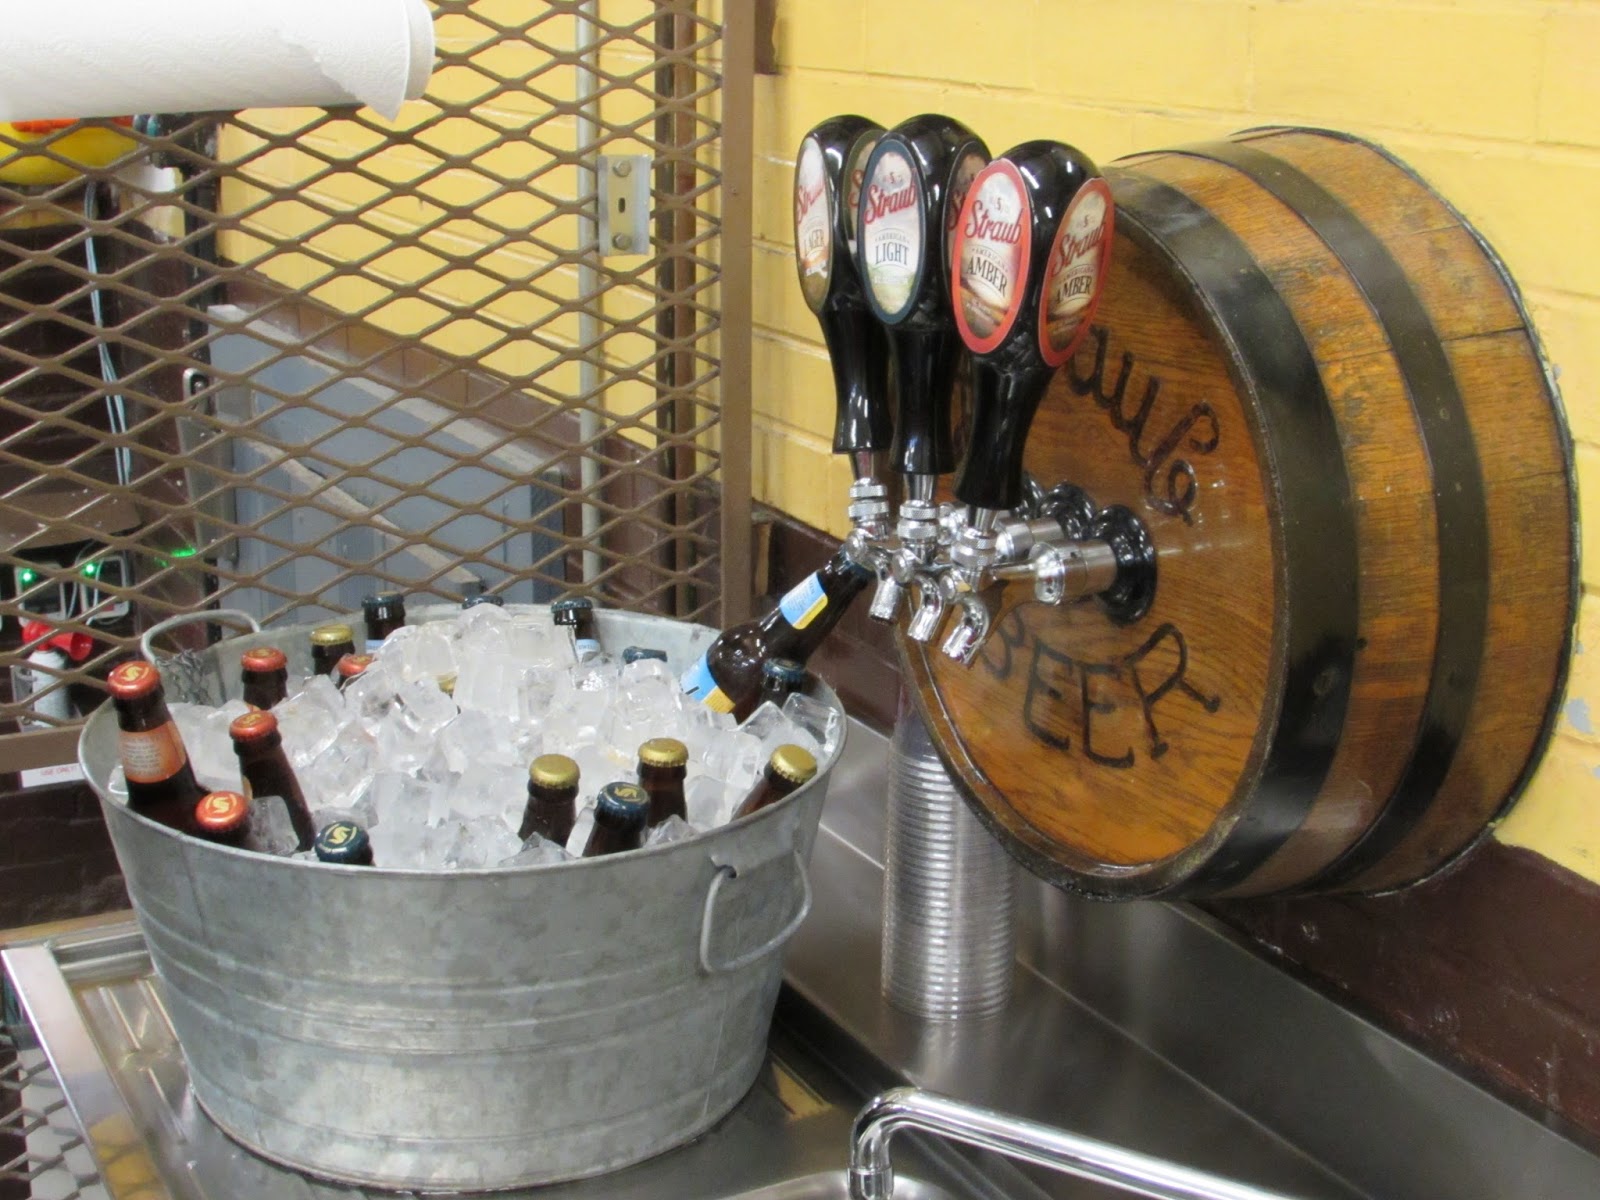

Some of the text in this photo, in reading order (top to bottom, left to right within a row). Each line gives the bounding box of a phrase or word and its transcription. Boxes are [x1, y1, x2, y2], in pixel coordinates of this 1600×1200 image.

[864, 168, 917, 224] Straub
[804, 229, 825, 257] LAGER
[965, 200, 1024, 245] Straub
[876, 241, 909, 266] LIGHT
[1052, 222, 1107, 275] Straub
[967, 256, 1008, 298] AMBER
[1057, 275, 1093, 304] AMBER
